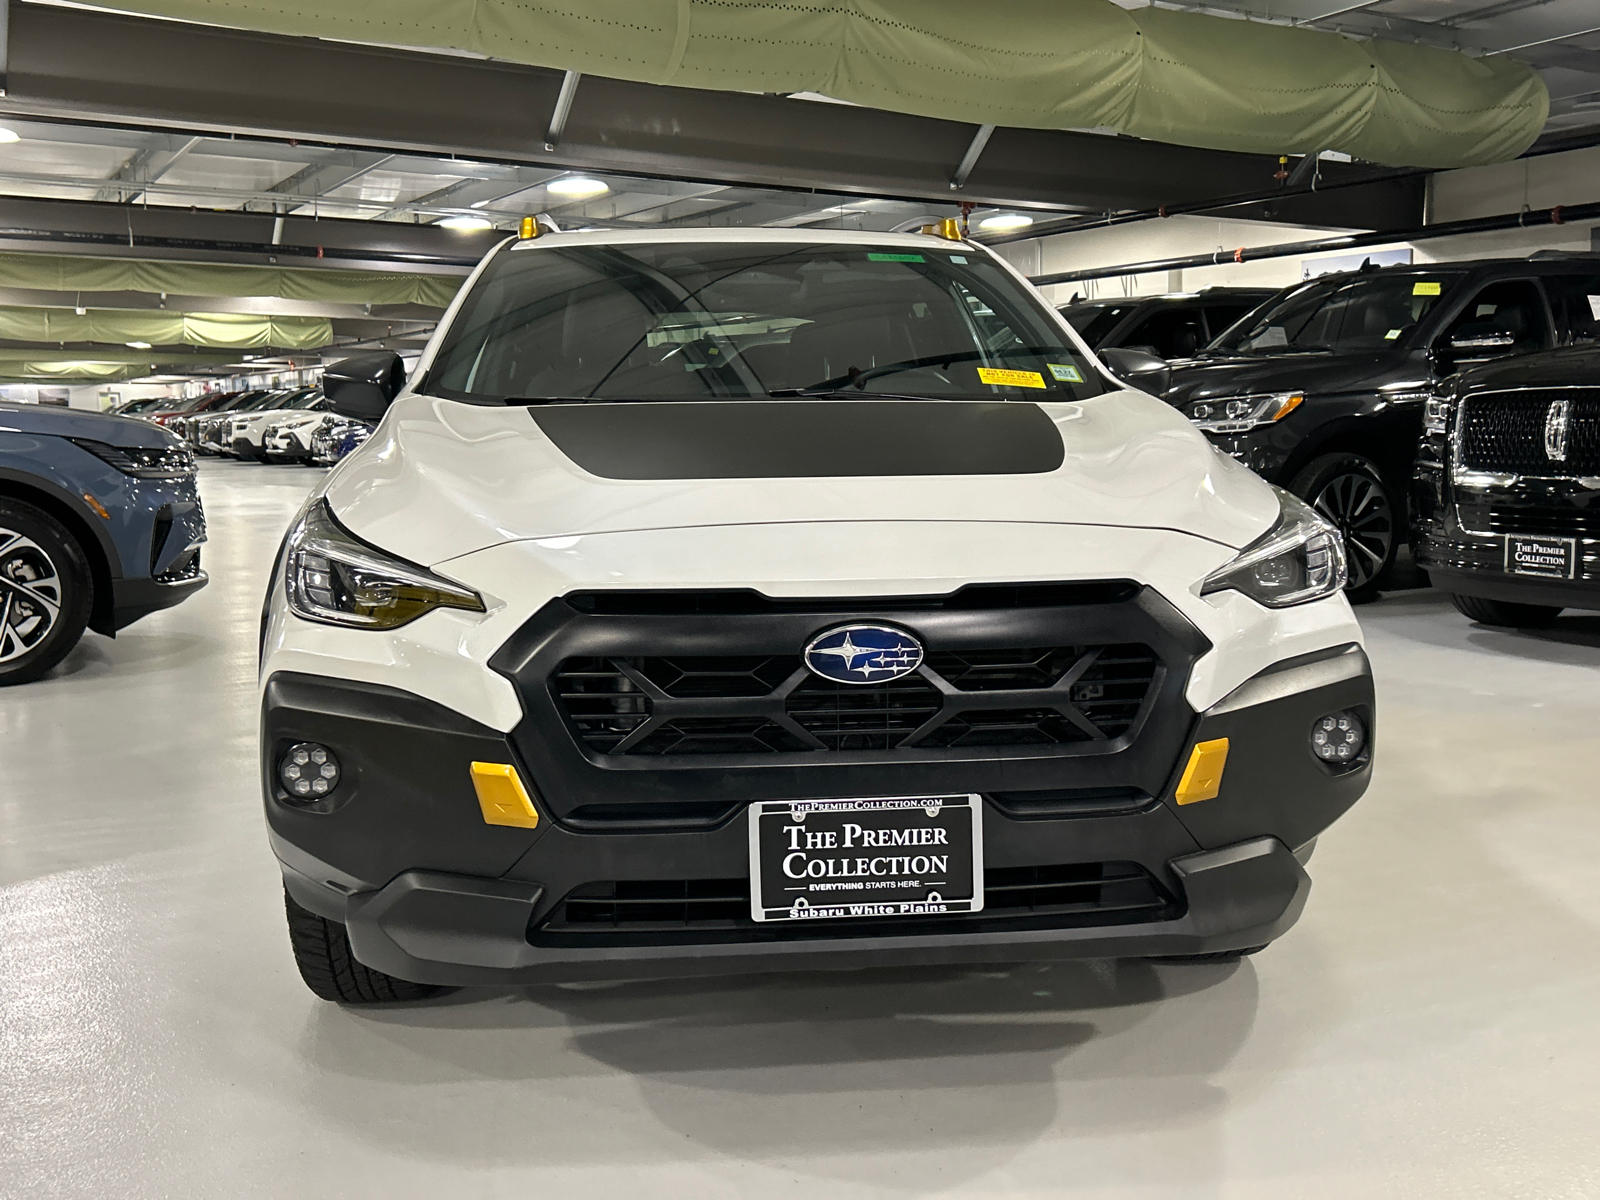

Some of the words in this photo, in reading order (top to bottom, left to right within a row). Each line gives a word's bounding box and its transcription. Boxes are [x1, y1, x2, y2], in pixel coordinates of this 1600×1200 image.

[1515, 542, 1532, 553] THE
[1532, 543, 1565, 556] PREMIER
[1514, 551, 1565, 565] COLLECTION
[782, 824, 838, 850] THE
[842, 823, 949, 848] PREMIER
[782, 852, 949, 879] COLLECTION
[809, 882, 864, 892] EVERYTHING
[865, 881, 897, 890] STARTS
[897, 880, 922, 888] HERE.
[789, 908, 845, 919] Subaru
[849, 905, 895, 916] White
[900, 902, 948, 914] Plains
